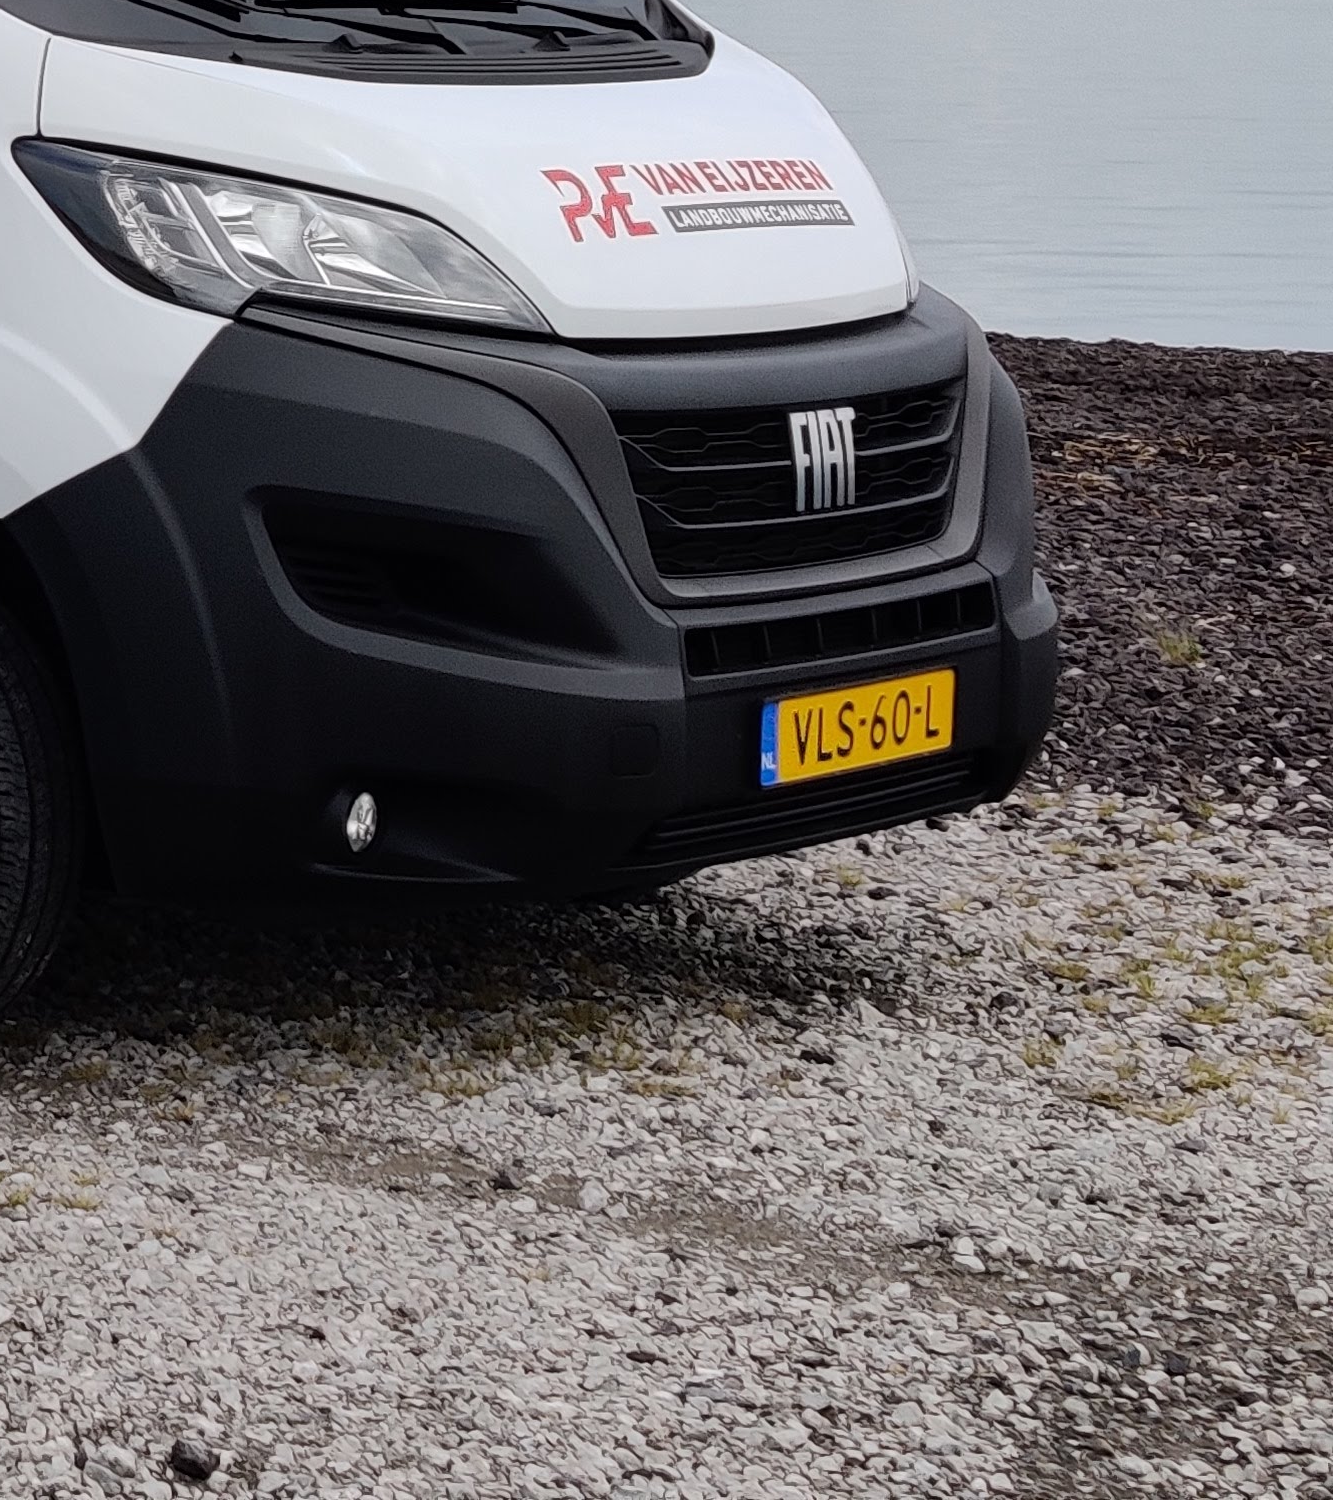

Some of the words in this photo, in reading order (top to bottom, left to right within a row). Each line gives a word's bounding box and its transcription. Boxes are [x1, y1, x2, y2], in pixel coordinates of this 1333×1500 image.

[631, 162, 707, 196] VAN
[693, 160, 834, 193] EIJZEREN
[668, 203, 847, 230] LANDBOUWMECHANISATIE
[789, 407, 856, 512] FIAT
[793, 685, 940, 765] VLS-60-L
[760, 752, 777, 771] NL
